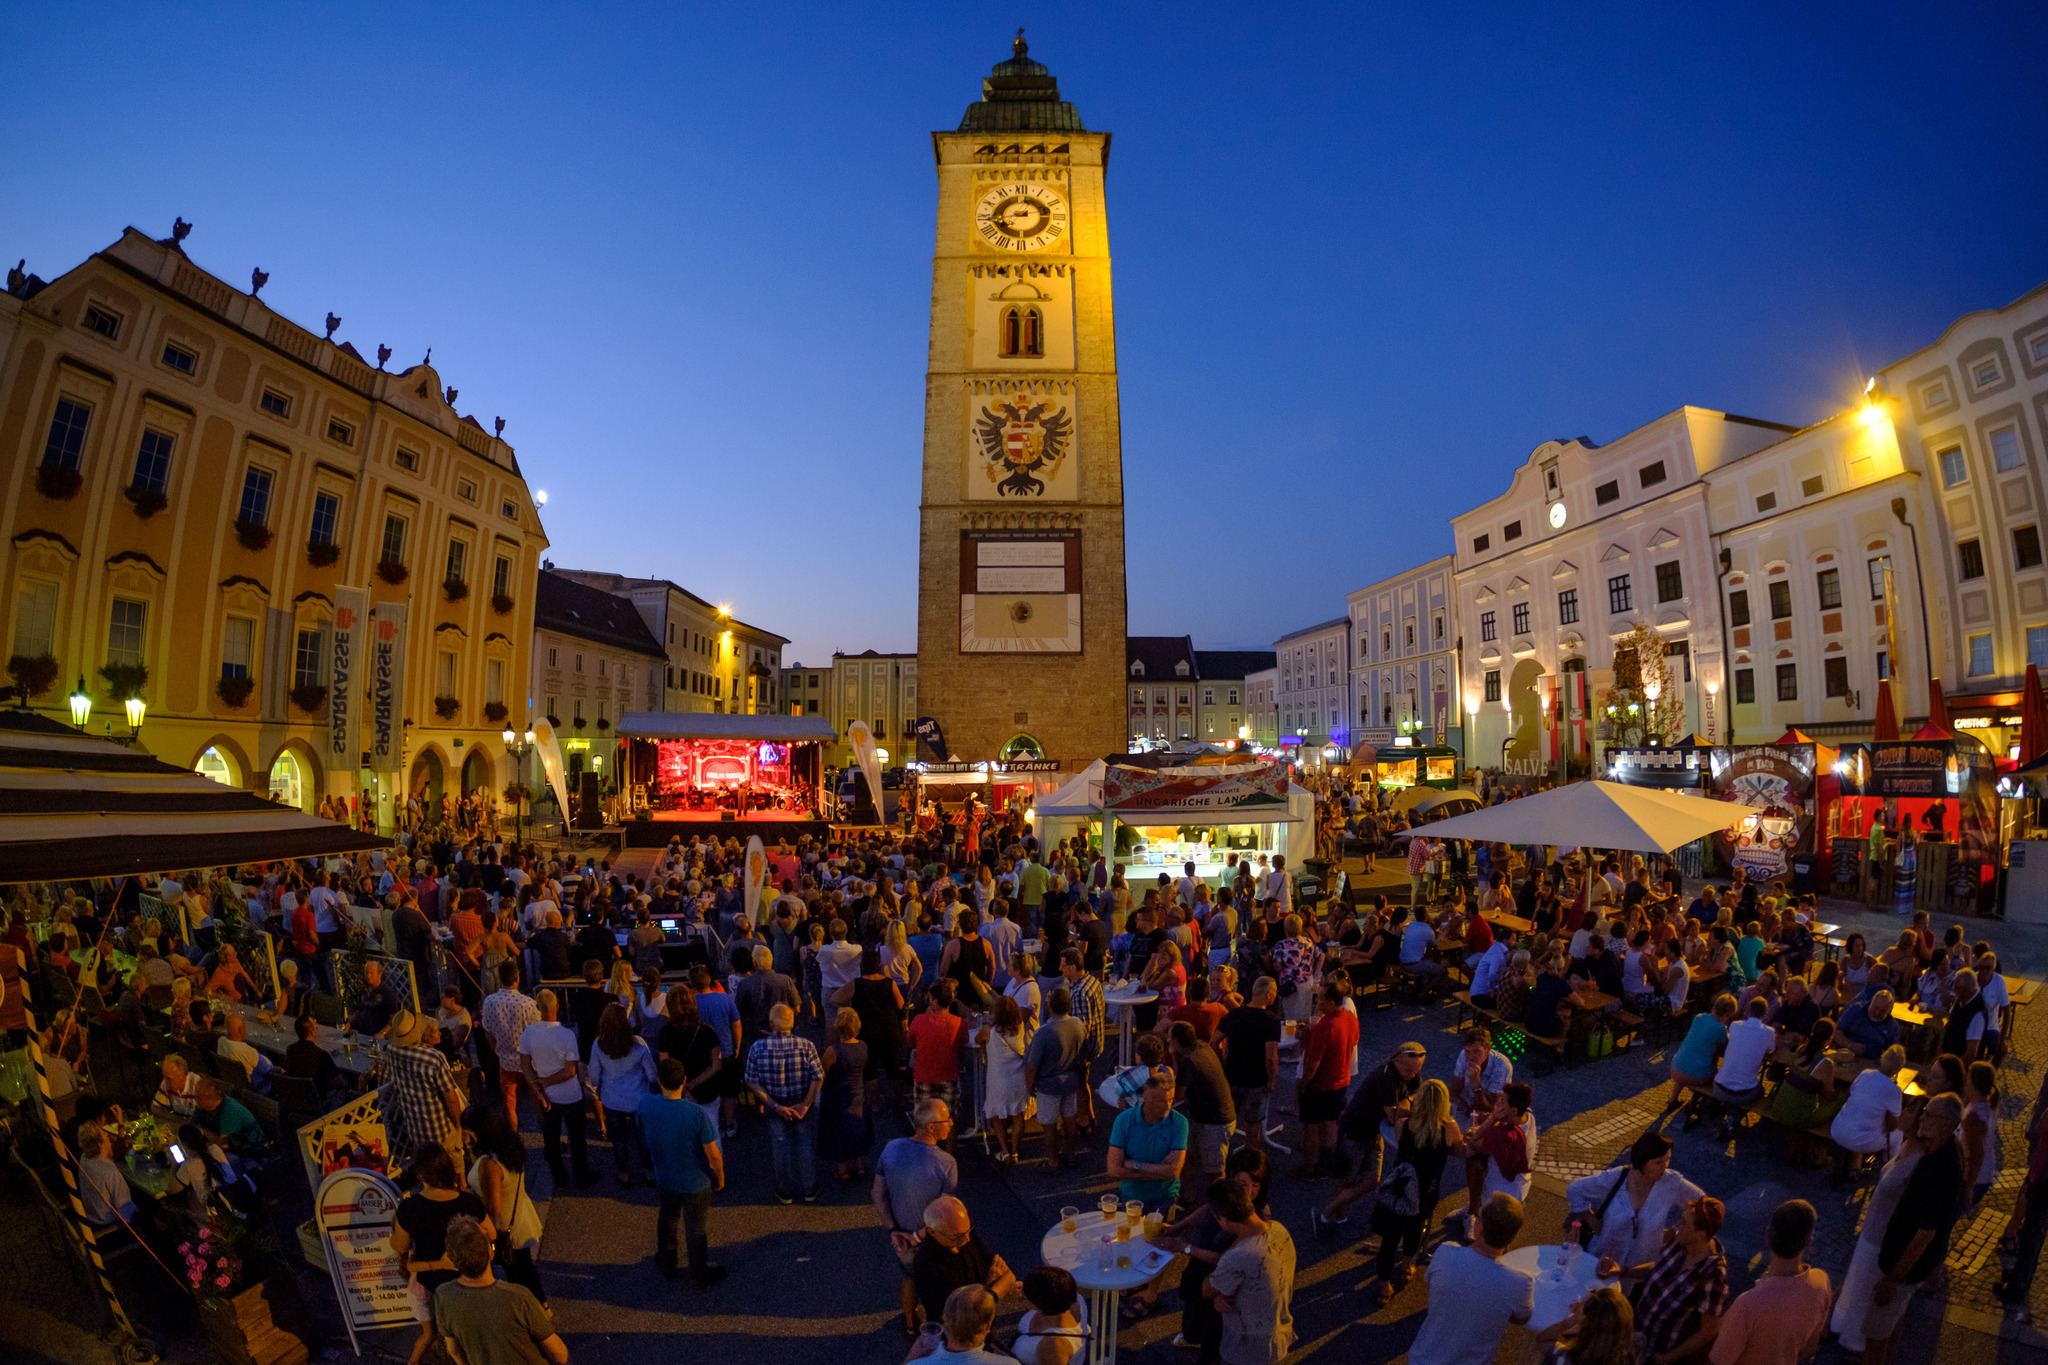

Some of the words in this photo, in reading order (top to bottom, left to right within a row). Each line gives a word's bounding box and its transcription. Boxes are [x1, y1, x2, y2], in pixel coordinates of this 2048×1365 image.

[1506, 758, 1549, 776] SALVE
[1136, 797, 1210, 807] UNGARISCHE
[360, 1200, 383, 1208] KAISER
[342, 1257, 400, 1268] ÖSTERREICHISCH
[345, 1270, 400, 1281] HAUSMANNSKOS
